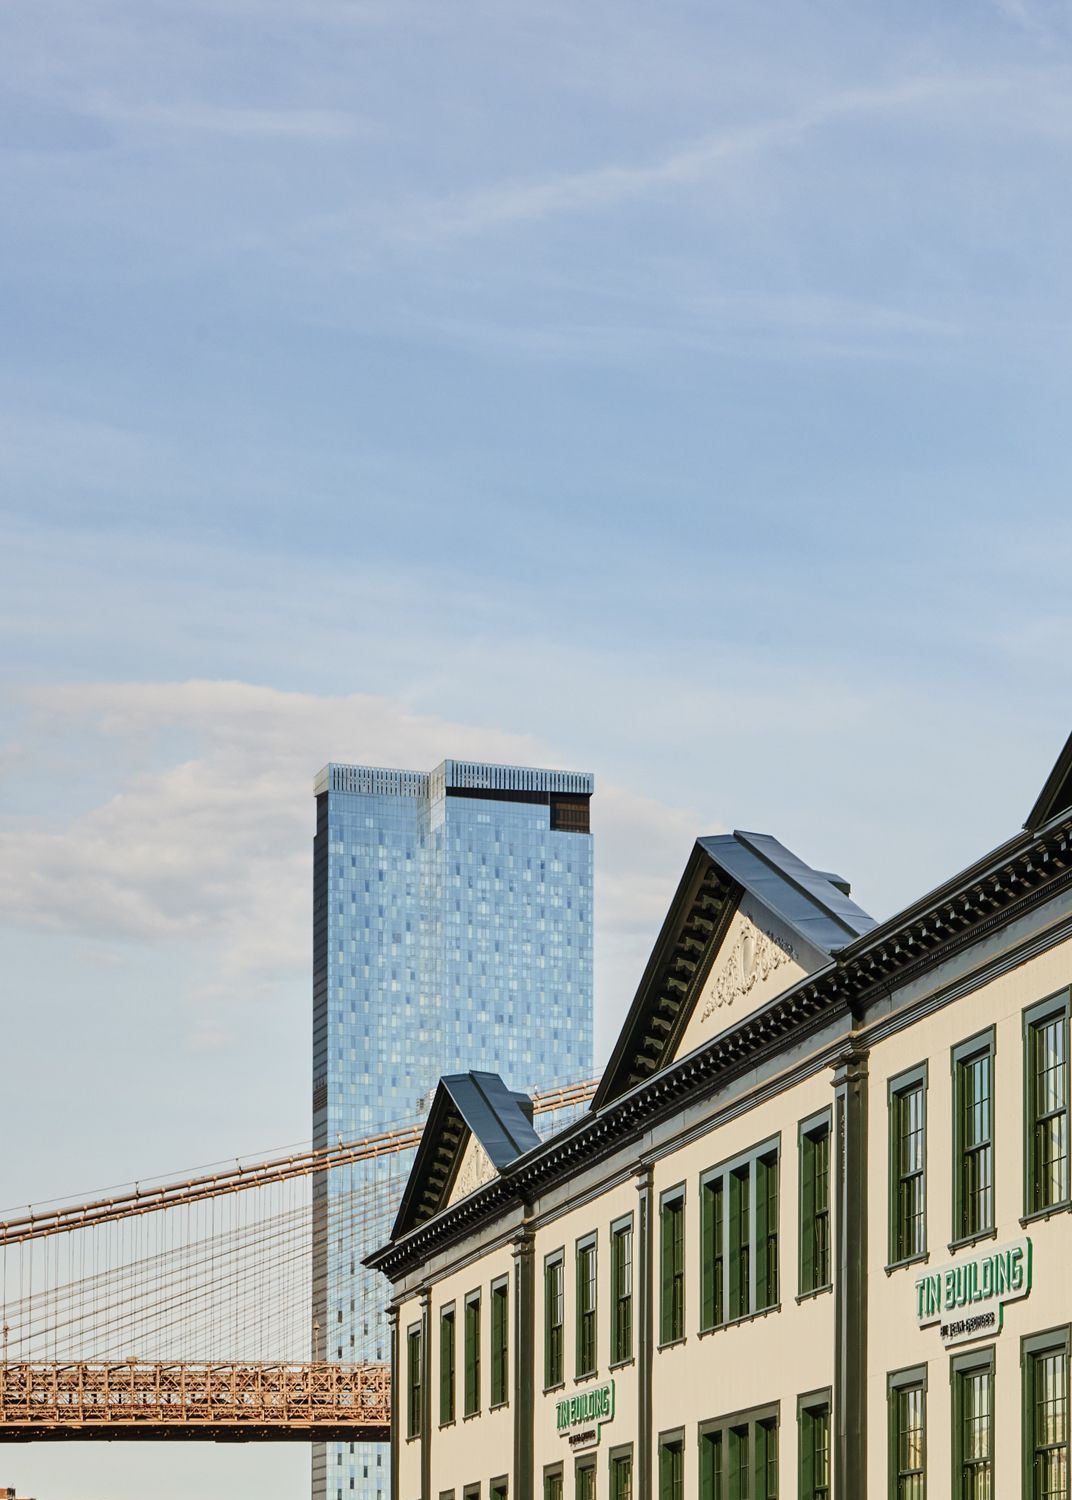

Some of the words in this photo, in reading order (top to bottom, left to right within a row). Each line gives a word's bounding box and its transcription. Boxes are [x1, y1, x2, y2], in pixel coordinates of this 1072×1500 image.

[915, 1273, 941, 1319] TIN
[944, 1247, 1024, 1311] BUILDING
[556, 1399, 570, 1431] TIN
[570, 1386, 610, 1426] BUILDING
